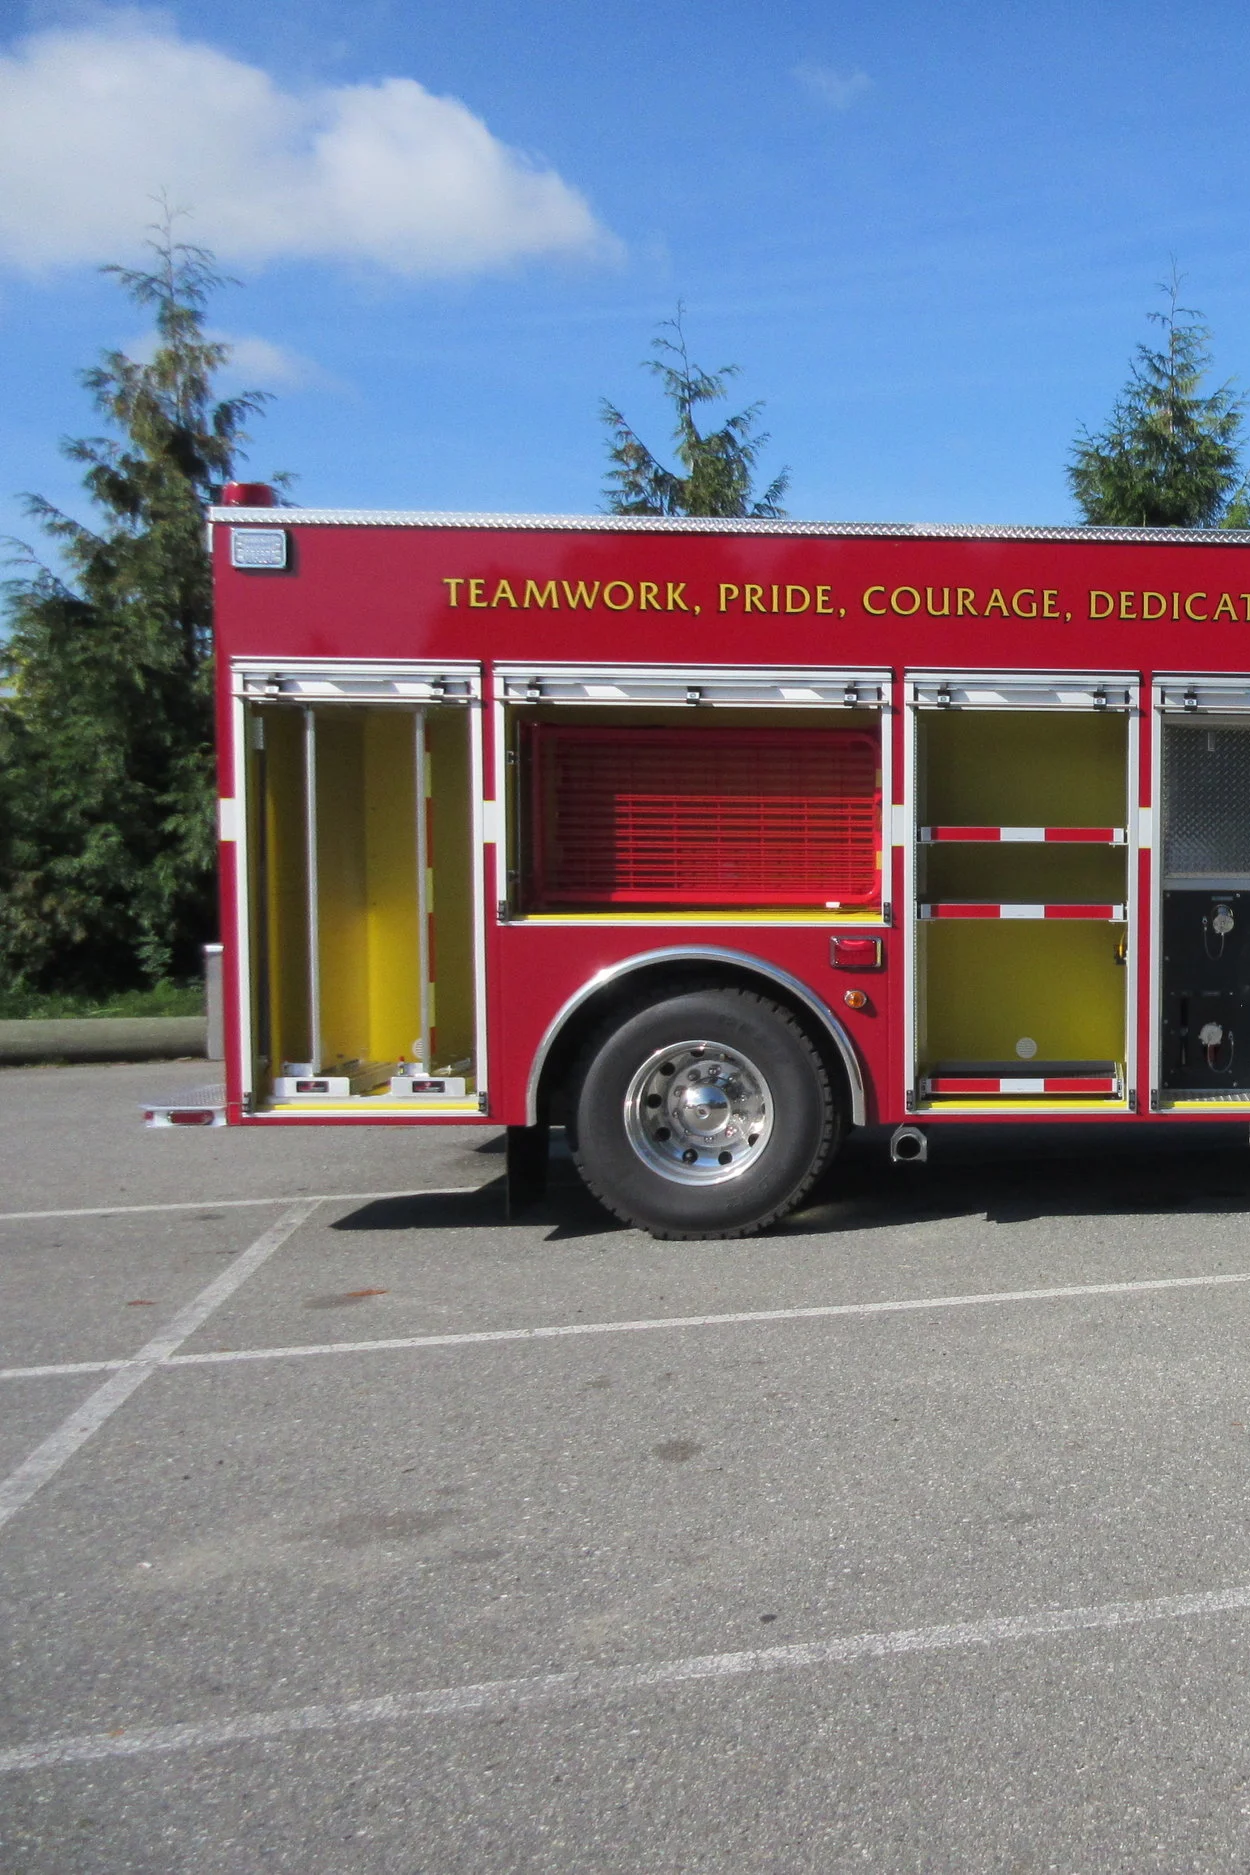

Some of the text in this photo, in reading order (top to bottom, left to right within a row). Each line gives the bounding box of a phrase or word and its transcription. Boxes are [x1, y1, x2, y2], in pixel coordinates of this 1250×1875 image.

[443, 578, 701, 616] TEAMWORK,
[718, 583, 846, 618] PRIDE,
[862, 586, 1072, 622] COURAGE,
